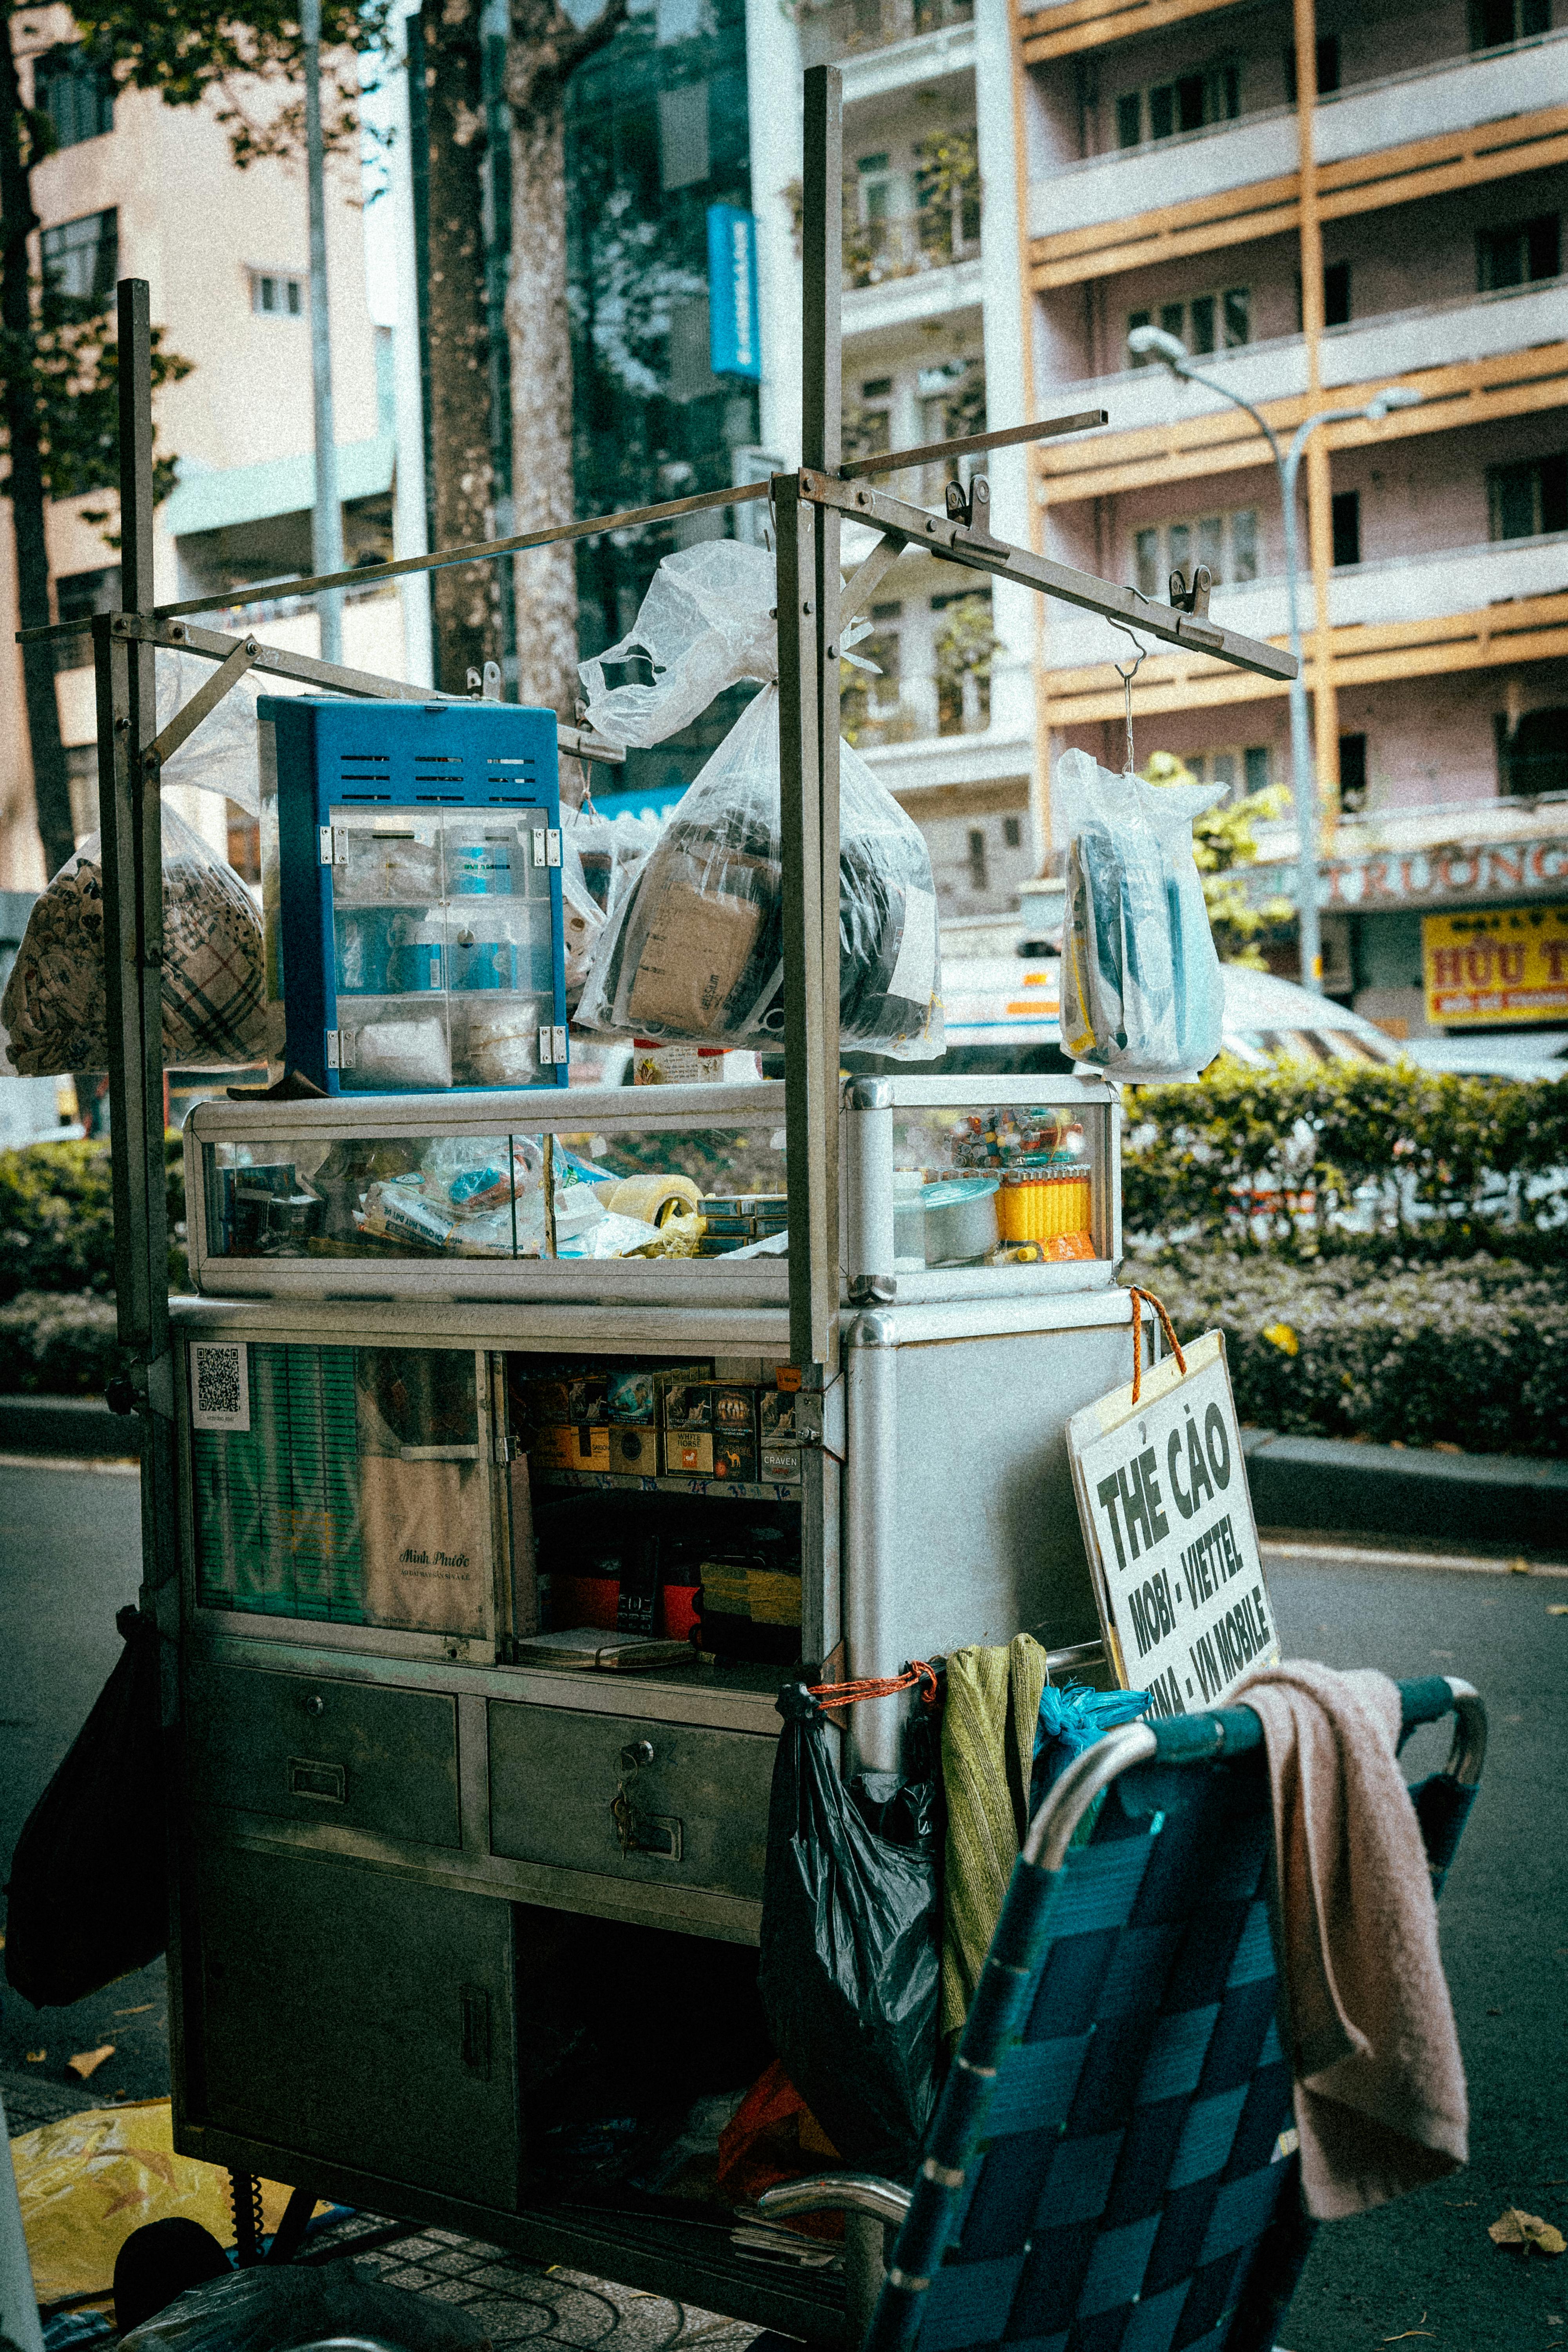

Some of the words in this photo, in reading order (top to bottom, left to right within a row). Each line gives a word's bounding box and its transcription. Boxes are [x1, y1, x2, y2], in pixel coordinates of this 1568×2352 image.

[717, 1445, 753, 1457] CAMEL
[764, 1456, 797, 1466] CRAVEN
[399, 1549, 430, 1564] Minh
[433, 1551, 470, 1567] Phước
[1128, 1568, 1176, 1658] MOBI
[1180, 1513, 1244, 1611] VIETTEL
[1189, 1631, 1223, 1704] VN
[1213, 1585, 1271, 1684] MOBILE
